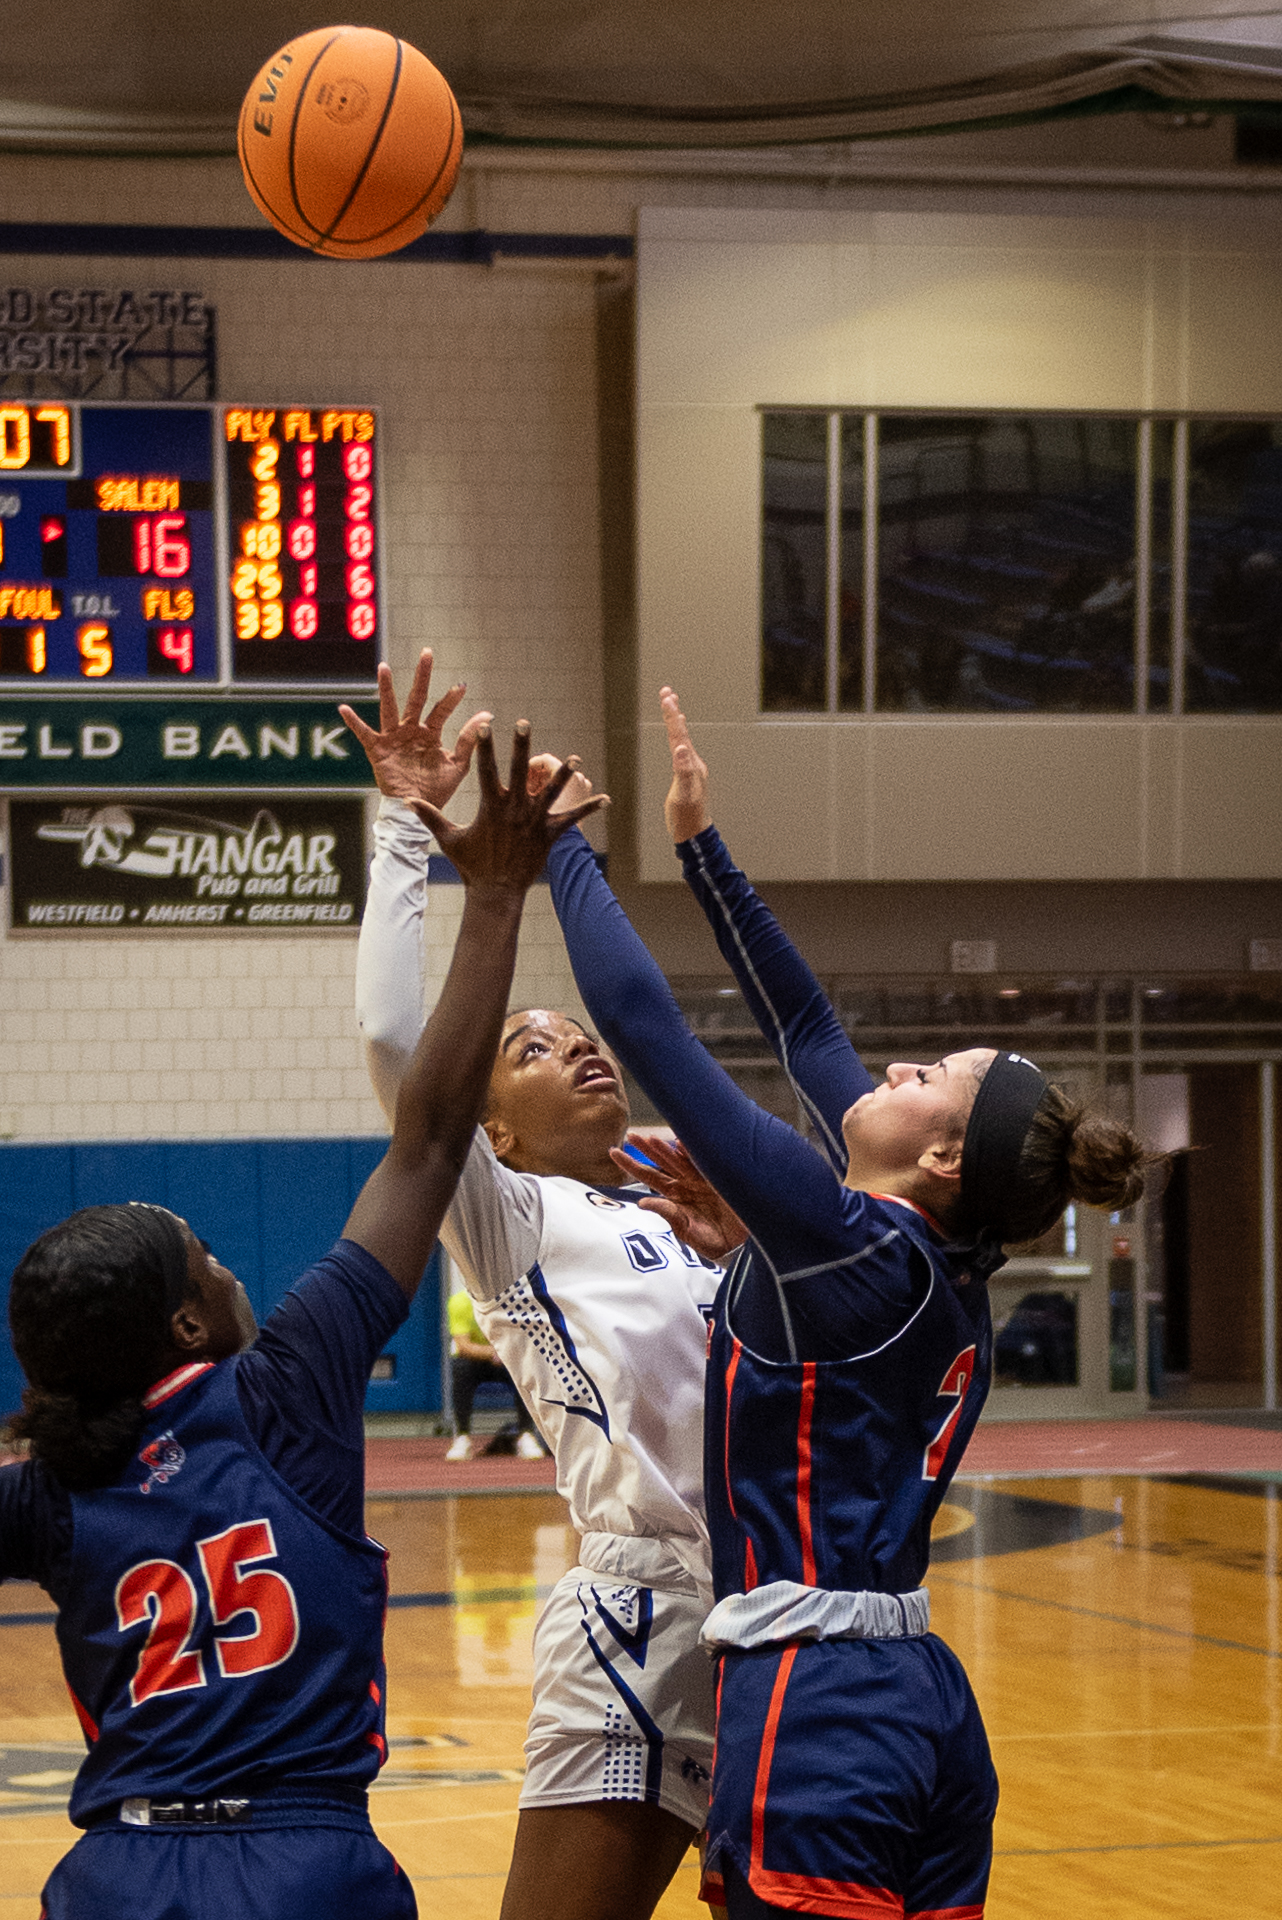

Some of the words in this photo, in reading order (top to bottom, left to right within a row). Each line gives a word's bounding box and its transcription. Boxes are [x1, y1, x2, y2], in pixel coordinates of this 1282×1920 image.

[50, 289, 203, 326] STATE
[0, 409, 70, 470] 07
[284, 411, 318, 443] FL
[322, 411, 374, 443] PTS
[253, 444, 279, 481] 2
[299, 445, 315, 478] 1
[345, 444, 373, 481] 0
[97, 478, 181, 512] SALEM
[257, 482, 280, 521] 3
[300, 484, 316, 518] 1
[346, 482, 373, 521] 2
[134, 516, 191, 578] 16
[243, 521, 281, 560] 10
[289, 521, 317, 561] 0
[346, 522, 374, 561] 0
[232, 561, 283, 600] 25
[303, 562, 318, 597] 1
[347, 561, 375, 600] 6
[142, 588, 194, 621] FLS
[236, 600, 284, 640] 33
[291, 600, 319, 640] 0
[348, 601, 376, 640] 0
[28, 626, 46, 674] 1
[77, 624, 113, 677] 5
[159, 628, 194, 674] 4
[163, 726, 350, 758] BANK
[155, 834, 337, 874] HANGAR
[197, 875, 241, 896] Pub
[244, 874, 289, 896] and
[292, 874, 341, 896] Grill
[28, 904, 125, 922] WESTFIELD
[144, 904, 229, 922] AMHERST
[248, 903, 352, 921] GREENFIELD
[115, 1518, 300, 1707] 25
